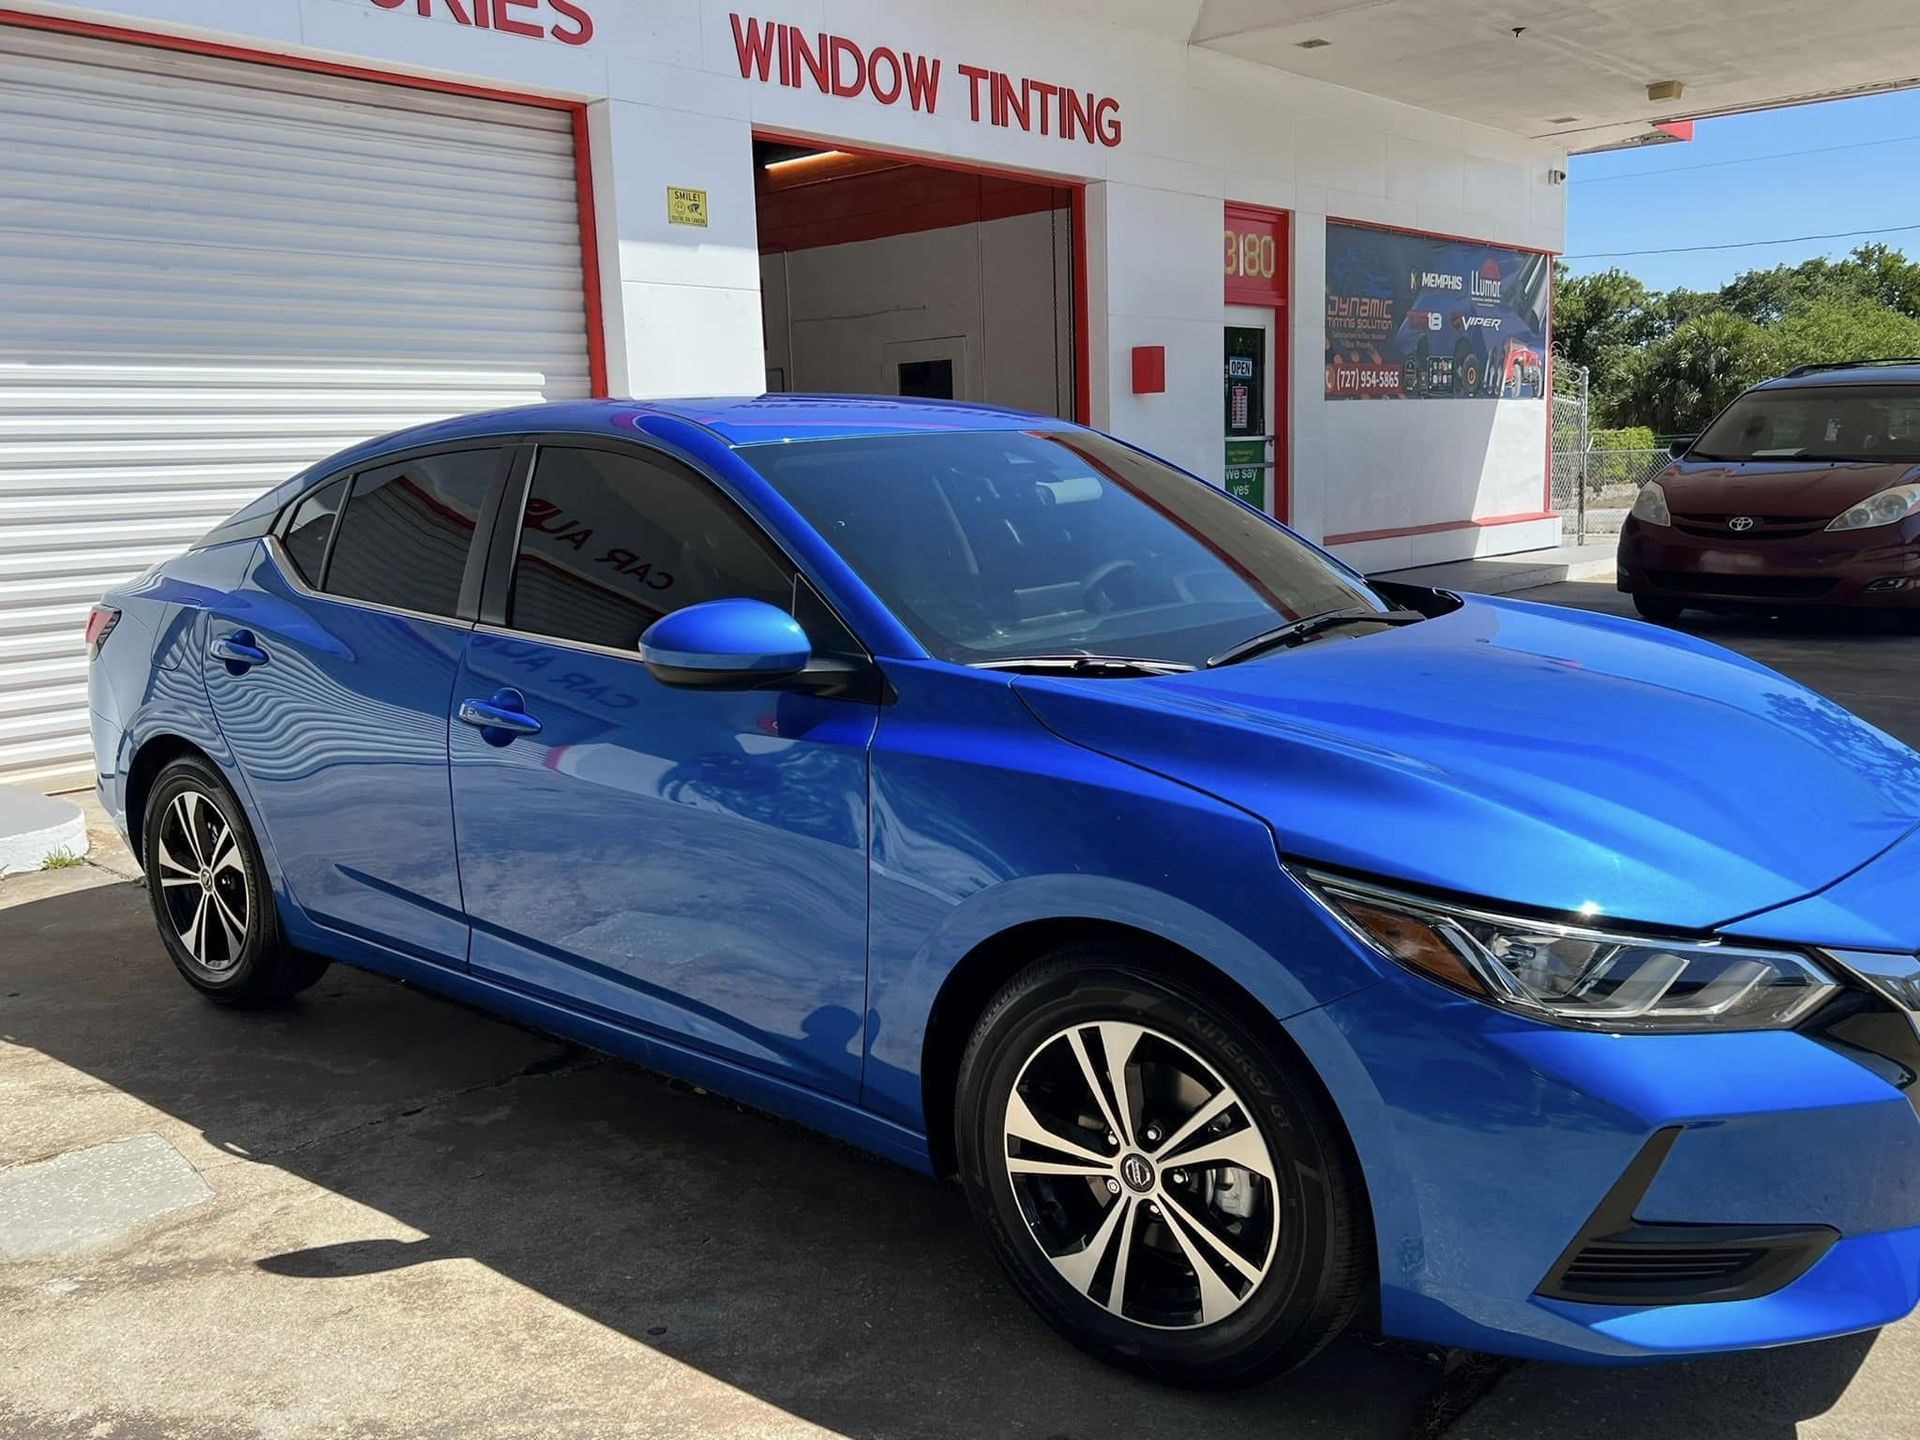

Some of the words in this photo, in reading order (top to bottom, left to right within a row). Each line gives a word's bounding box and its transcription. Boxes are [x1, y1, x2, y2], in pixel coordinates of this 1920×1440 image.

[729, 13, 941, 114] WINDOW
[958, 64, 1122, 148] TINTING
[674, 190, 700, 202] SMILE!
[1225, 230, 1276, 278] 3180
[1422, 271, 1462, 291] MEMPHIS
[1357, 318, 1393, 330] SOLUTION
[1462, 316, 1501, 331] VIPER
[1231, 361, 1250, 376] OPEN
[1337, 368, 1359, 390] (727)
[1361, 371, 1399, 388] 954-5865
[1241, 468, 1257, 481] say
